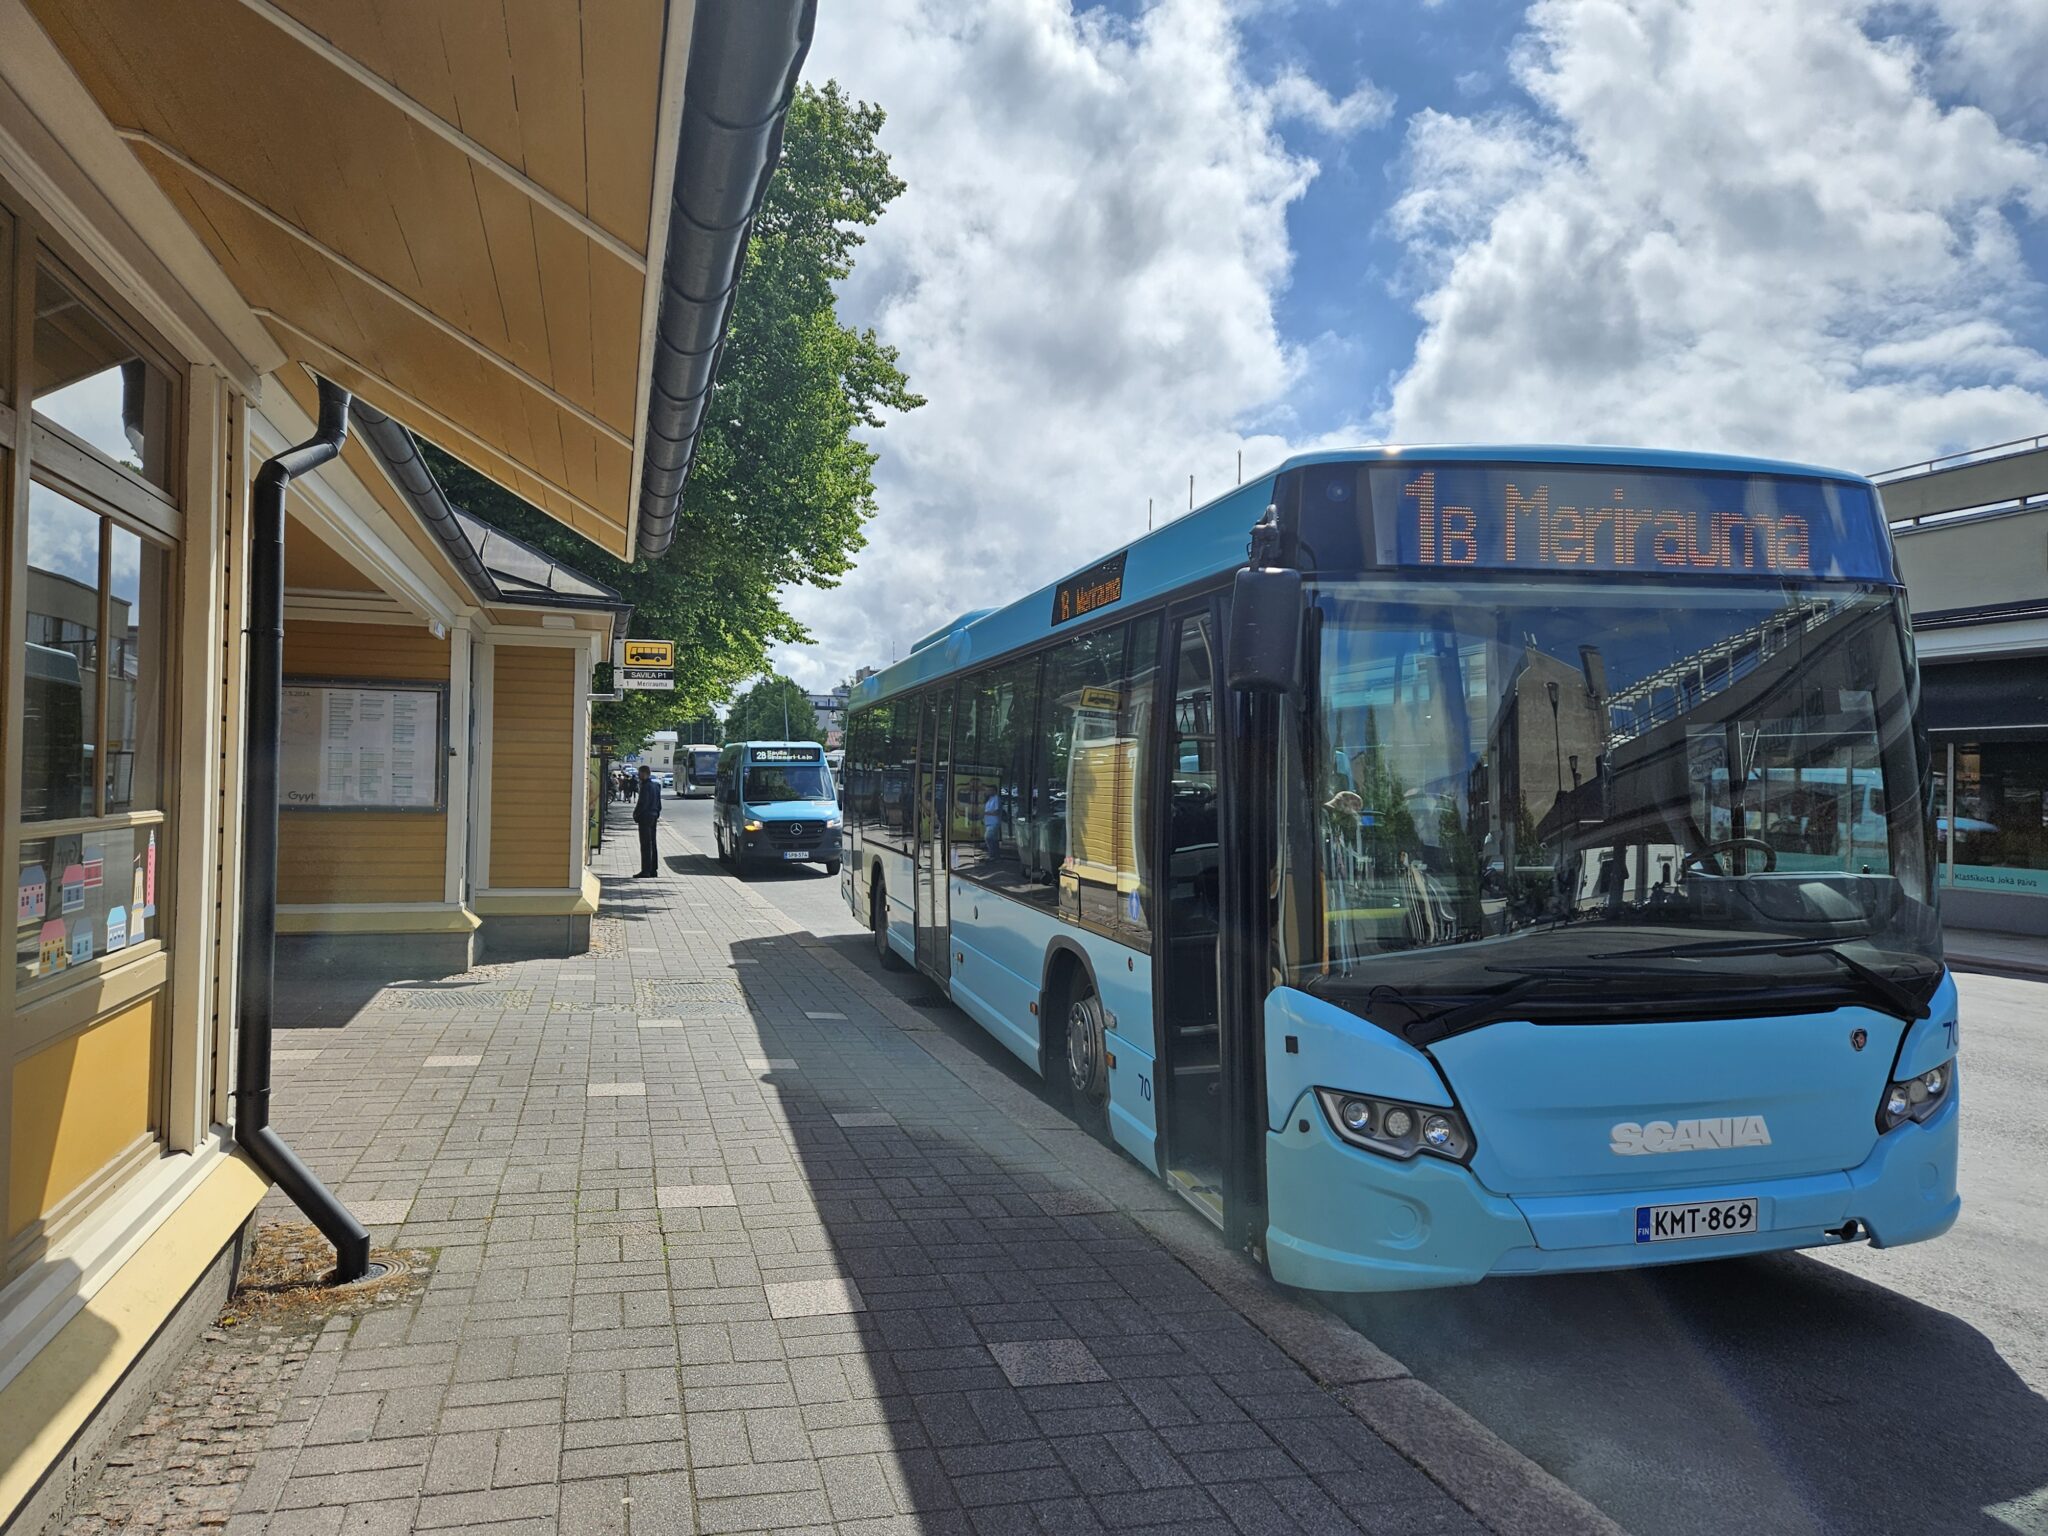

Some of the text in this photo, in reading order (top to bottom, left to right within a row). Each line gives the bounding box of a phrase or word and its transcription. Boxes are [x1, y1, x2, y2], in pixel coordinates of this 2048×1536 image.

[1405, 472, 1809, 569] 1B Merirauma
[631, 671, 656, 679] SAVILA
[1138, 1073, 1152, 1101] 70
[1610, 1115, 1772, 1155] SCANIA
[1637, 1227, 1650, 1236] FIN
